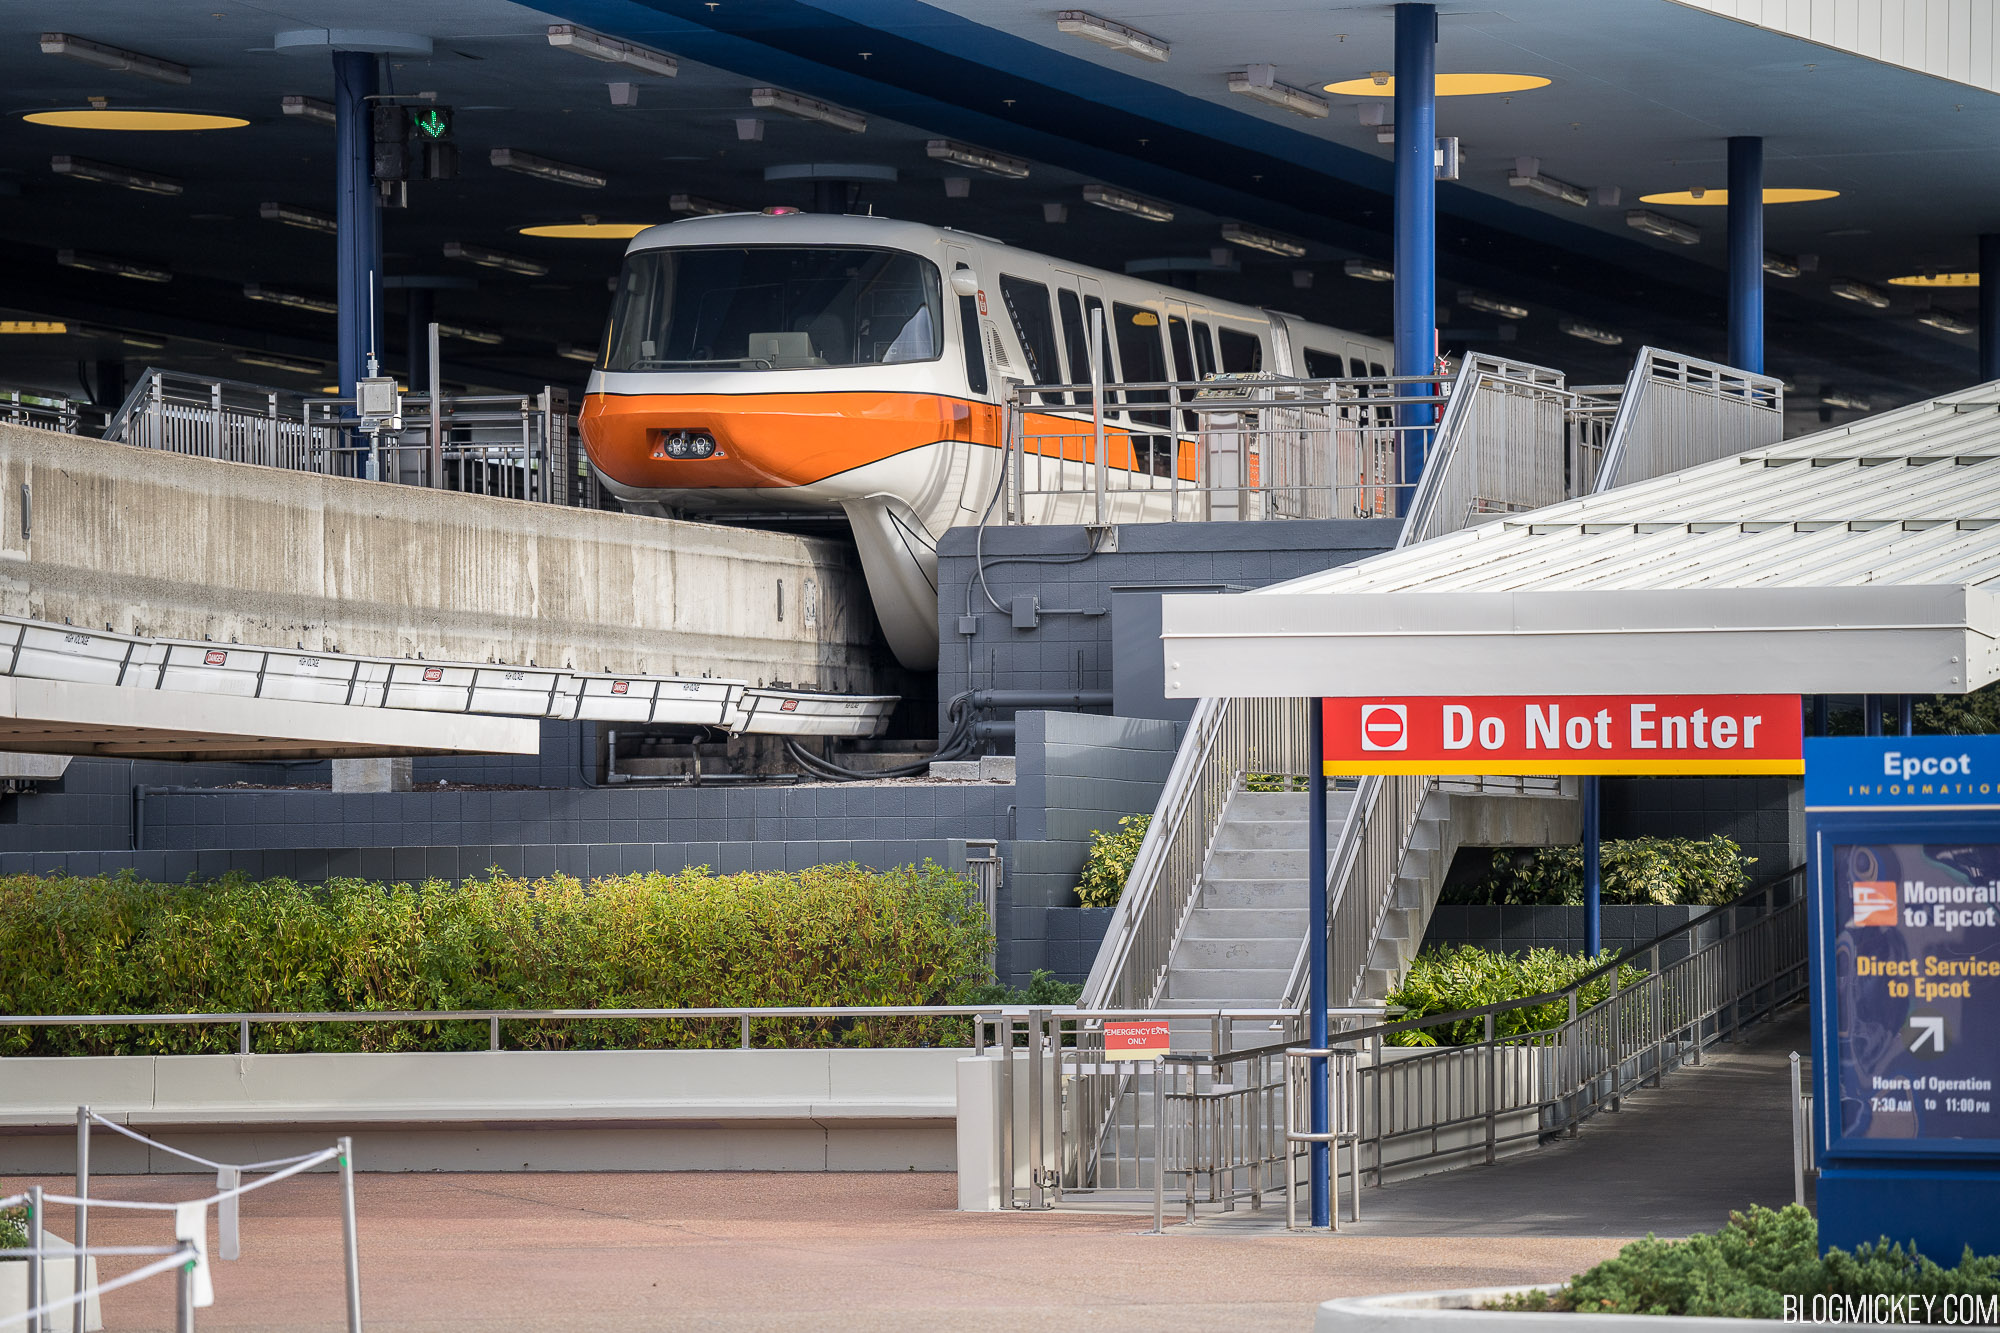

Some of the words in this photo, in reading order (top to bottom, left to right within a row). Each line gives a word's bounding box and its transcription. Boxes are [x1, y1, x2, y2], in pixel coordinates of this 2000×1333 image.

[208, 653, 224, 661] DANGER
[426, 670, 440, 679] DANGER
[1443, 704, 1505, 750] Do
[1525, 704, 1612, 750] Not
[1631, 703, 1762, 749] Enter
[1884, 752, 1971, 781] Epcot
[1903, 881, 2000, 904] Monorail
[1903, 907, 1928, 928] to
[1933, 905, 1996, 932] Epcot
[1857, 956, 1919, 977] Direct
[1925, 956, 2000, 977] Service
[1888, 980, 1909, 998] to
[1915, 978, 1971, 1002] Epcot
[1107, 1028, 1151, 1036] EMERGENCY
[1127, 1037, 1147, 1045] ONLY
[1872, 1076, 1911, 1090] Hours
[1913, 1077, 1926, 1090] of
[1928, 1077, 1992, 1093] Operation
[1871, 1097, 1896, 1112] 7:30
[1897, 1100, 1912, 1112] AM
[1924, 1098, 1937, 1110] to
[1946, 1098, 1974, 1112] 11:00
[1976, 1101, 1990, 1112] PM
